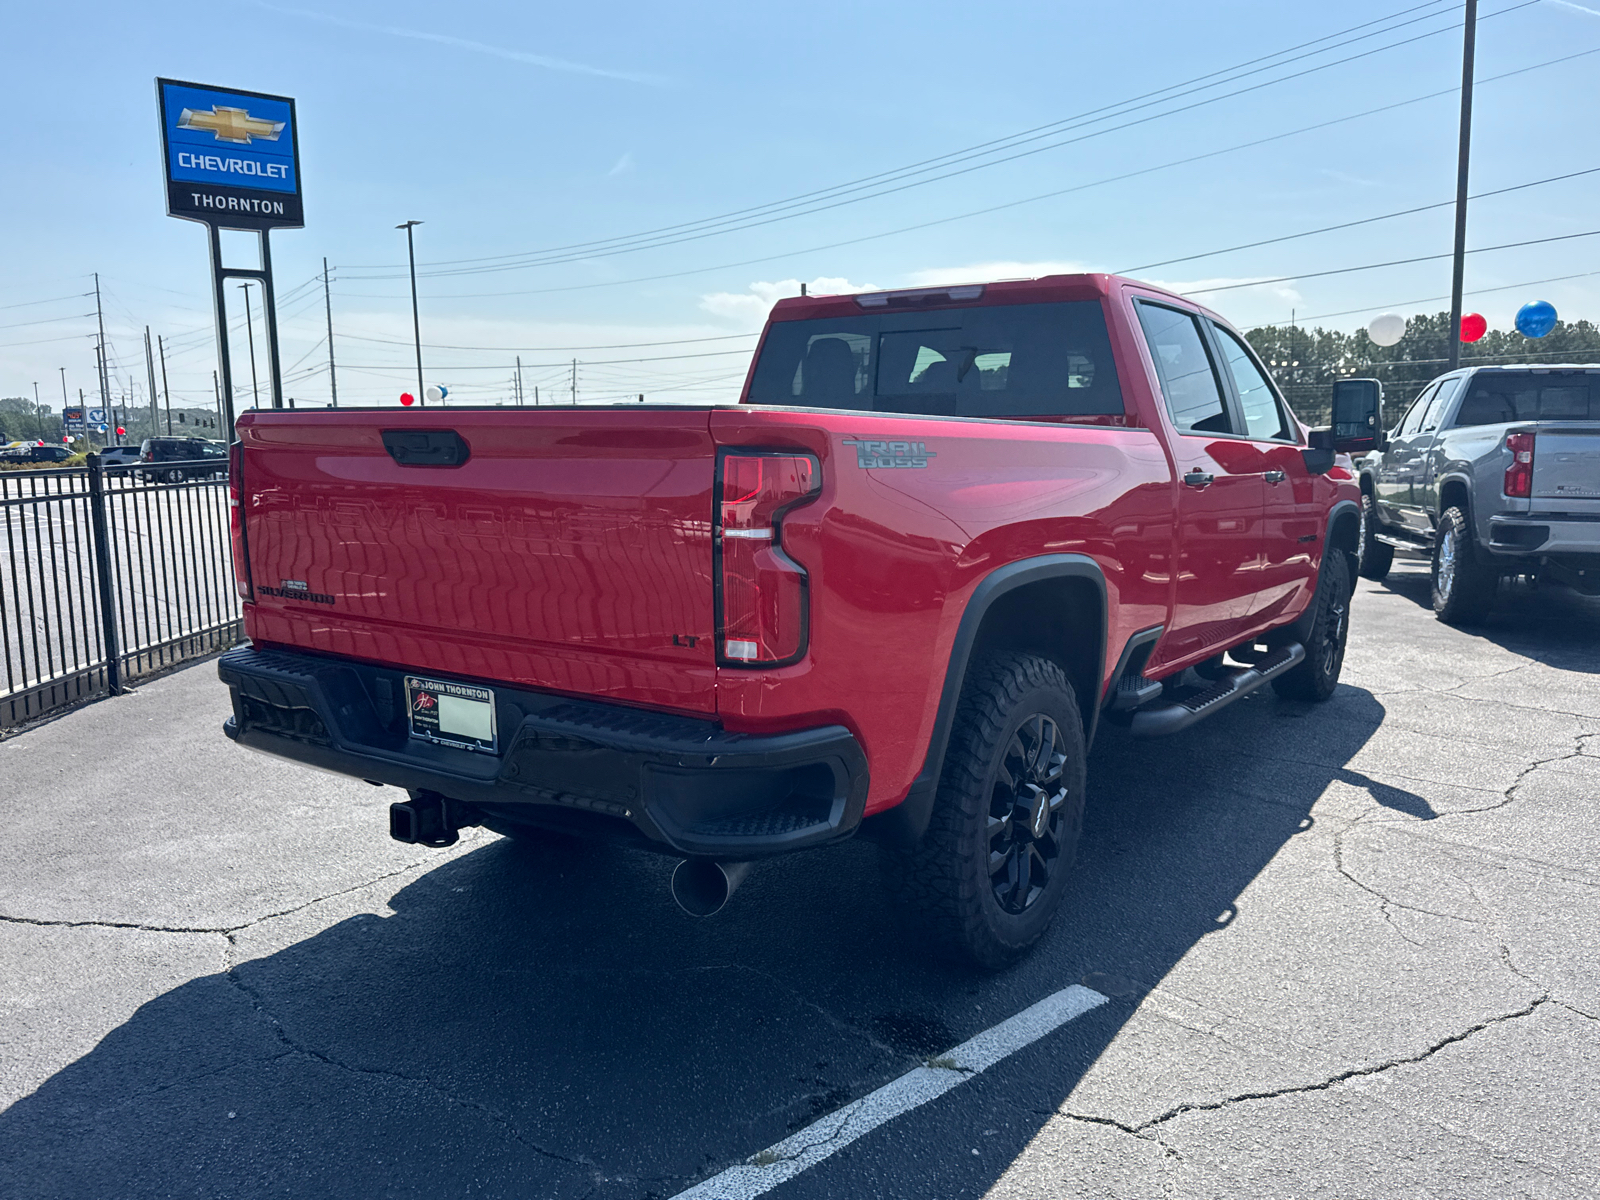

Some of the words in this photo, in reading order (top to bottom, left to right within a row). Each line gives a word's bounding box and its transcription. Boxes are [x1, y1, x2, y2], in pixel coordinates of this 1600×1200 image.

[178, 152, 289, 179] CHEVROLET
[191, 193, 284, 215] THORNTON
[842, 440, 937, 457] TRAIL
[857, 456, 928, 469] BOSS
[257, 585, 335, 605] SILVERADO
[672, 633, 700, 648] LT
[424, 681, 445, 692] JOHN
[446, 685, 488, 699] THORNTON
[440, 740, 466, 749] CHEVROLET
